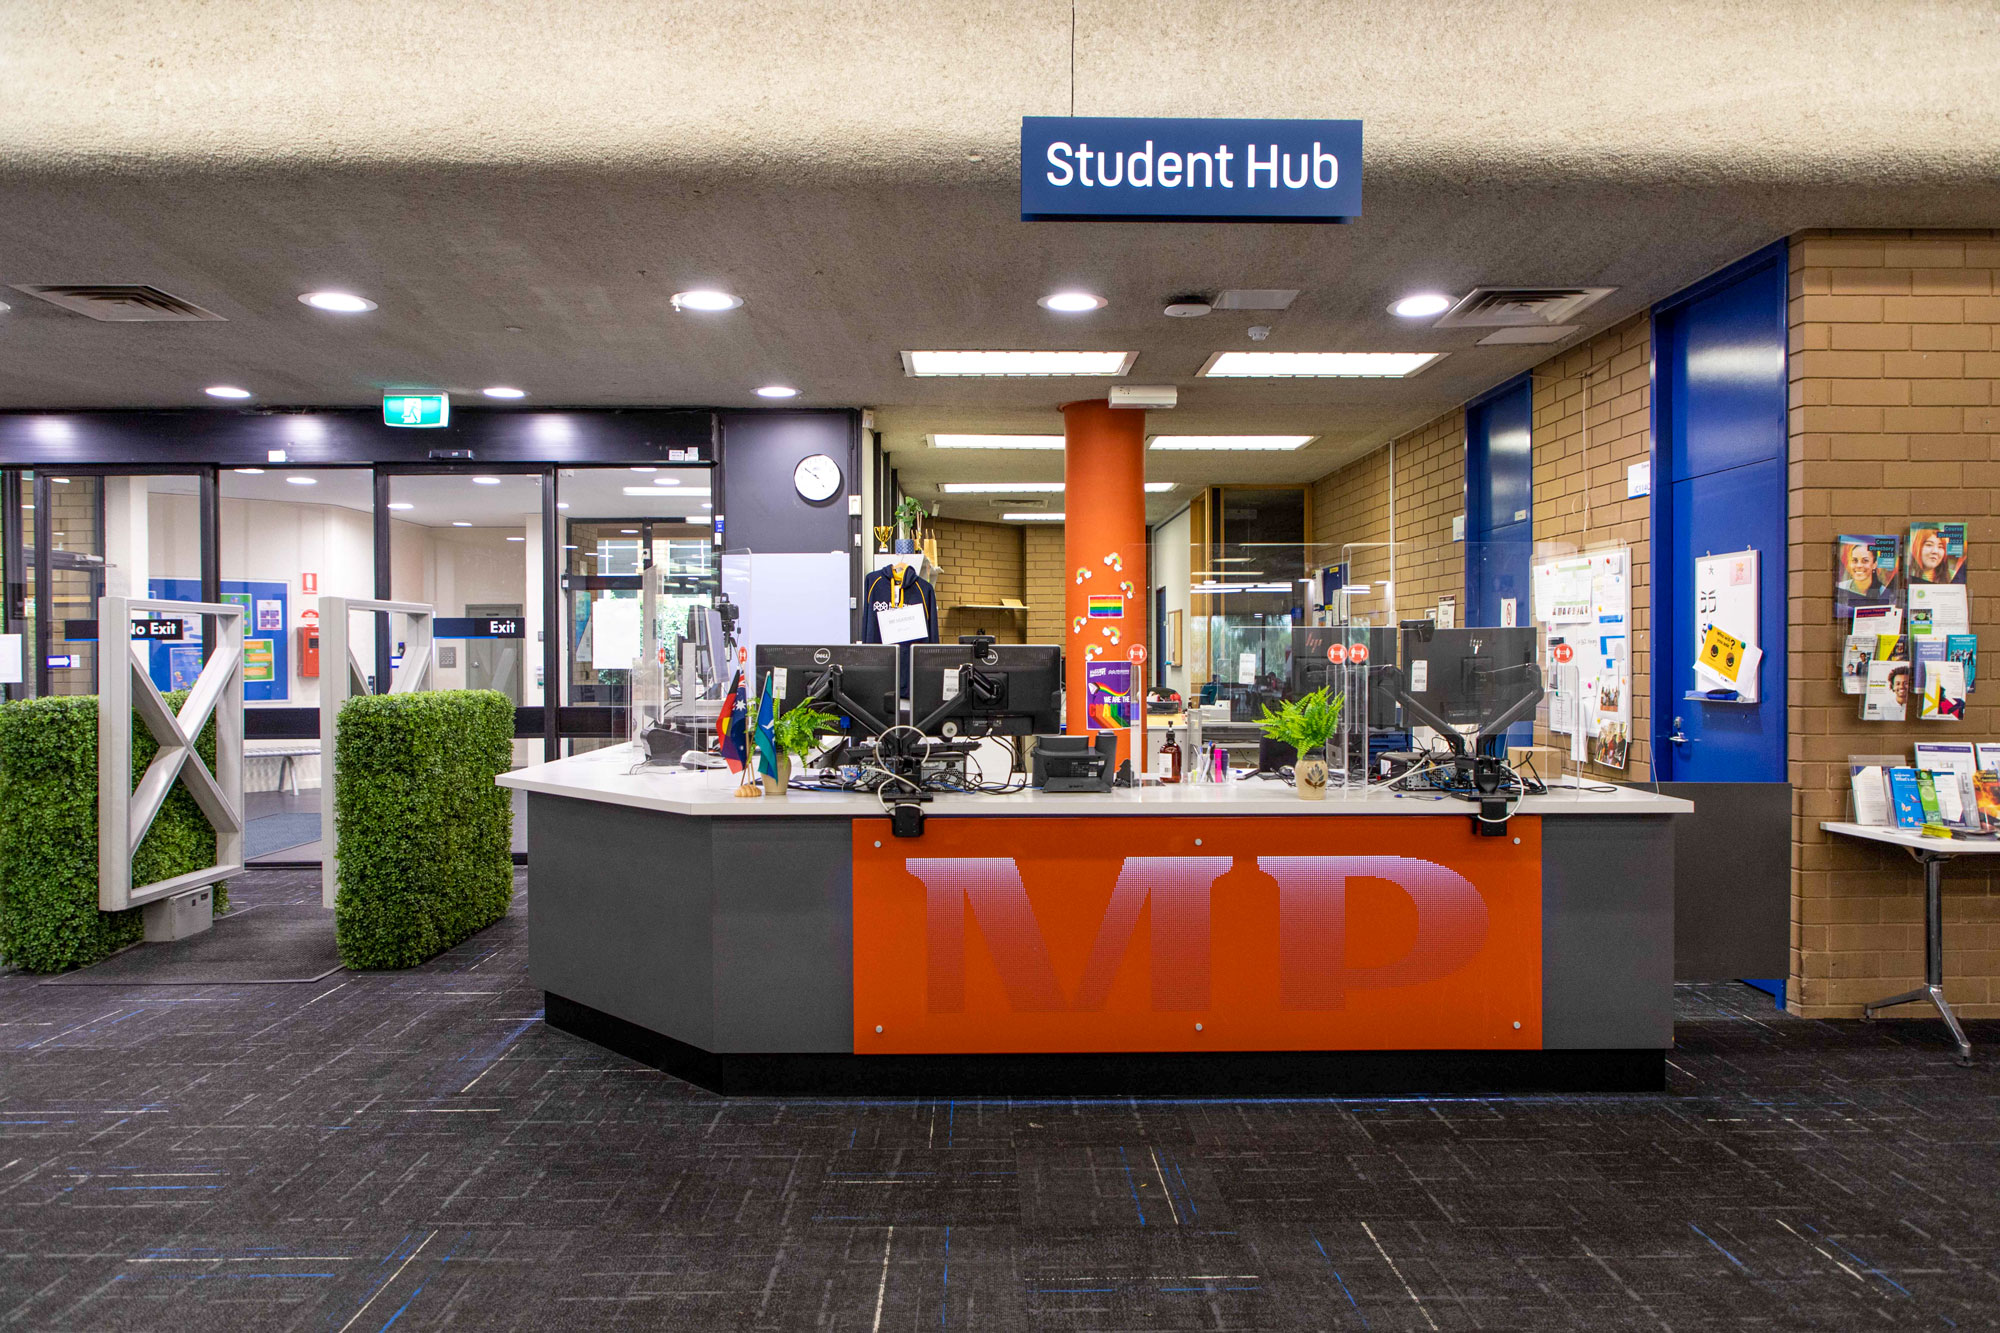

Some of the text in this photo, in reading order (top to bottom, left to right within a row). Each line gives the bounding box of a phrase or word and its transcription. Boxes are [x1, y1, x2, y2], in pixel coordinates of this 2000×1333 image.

[1046, 140, 1339, 189] Student Hub
[150, 621, 176, 635] Exit
[490, 620, 516, 634] Exit
[906, 856, 1489, 1013] MP
